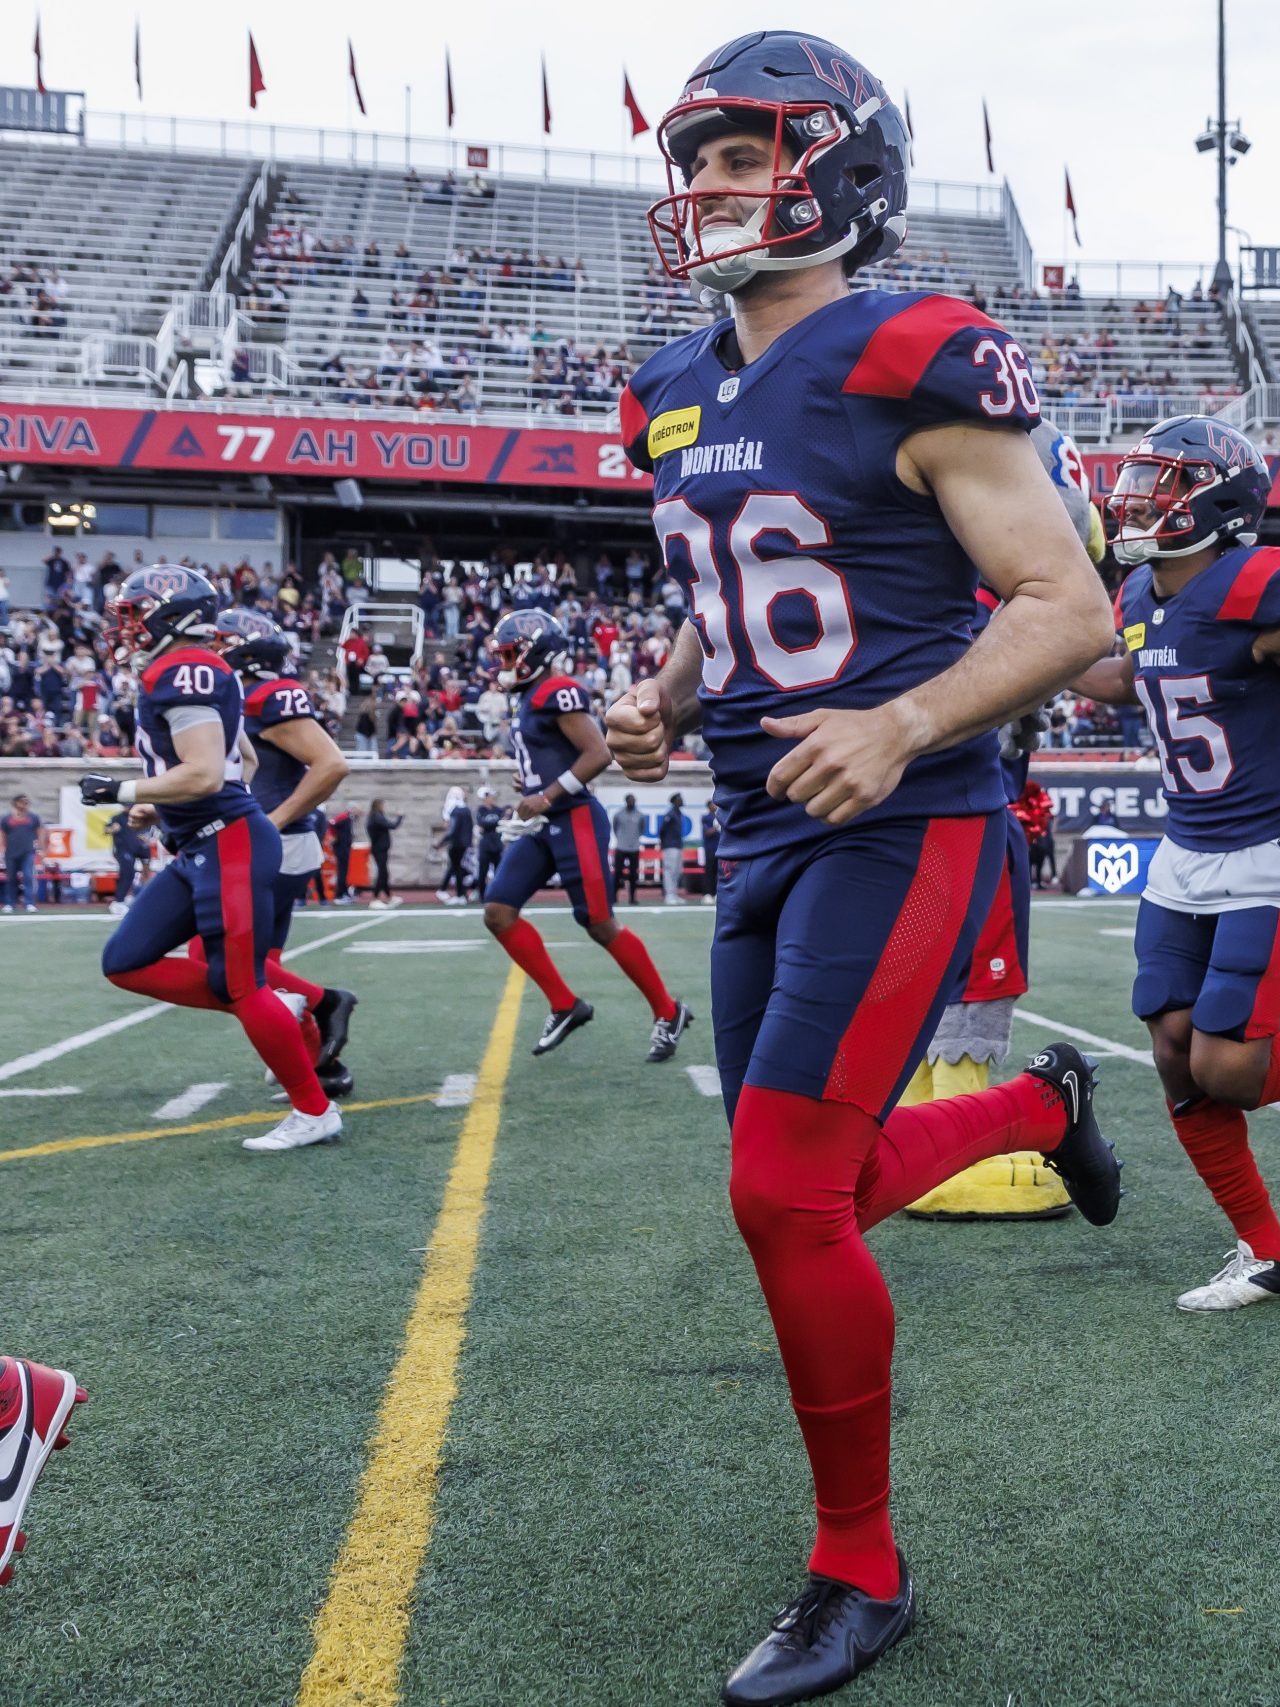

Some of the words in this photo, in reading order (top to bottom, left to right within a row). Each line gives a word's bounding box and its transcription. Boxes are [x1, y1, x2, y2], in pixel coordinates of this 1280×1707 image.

[972, 336, 1041, 418] 36
[217, 425, 274, 461] 77
[287, 427, 357, 466] AH
[371, 430, 470, 471] YOU
[651, 419, 695, 444] VIDÉOTRON
[598, 444, 643, 479] 2
[680, 436, 763, 478] MONTRÉAL
[652, 489, 859, 695] 36
[1138, 645, 1179, 669] MONTRÉAL
[172, 664, 214, 695] 40
[275, 688, 311, 717] 72
[555, 686, 584, 713] 81
